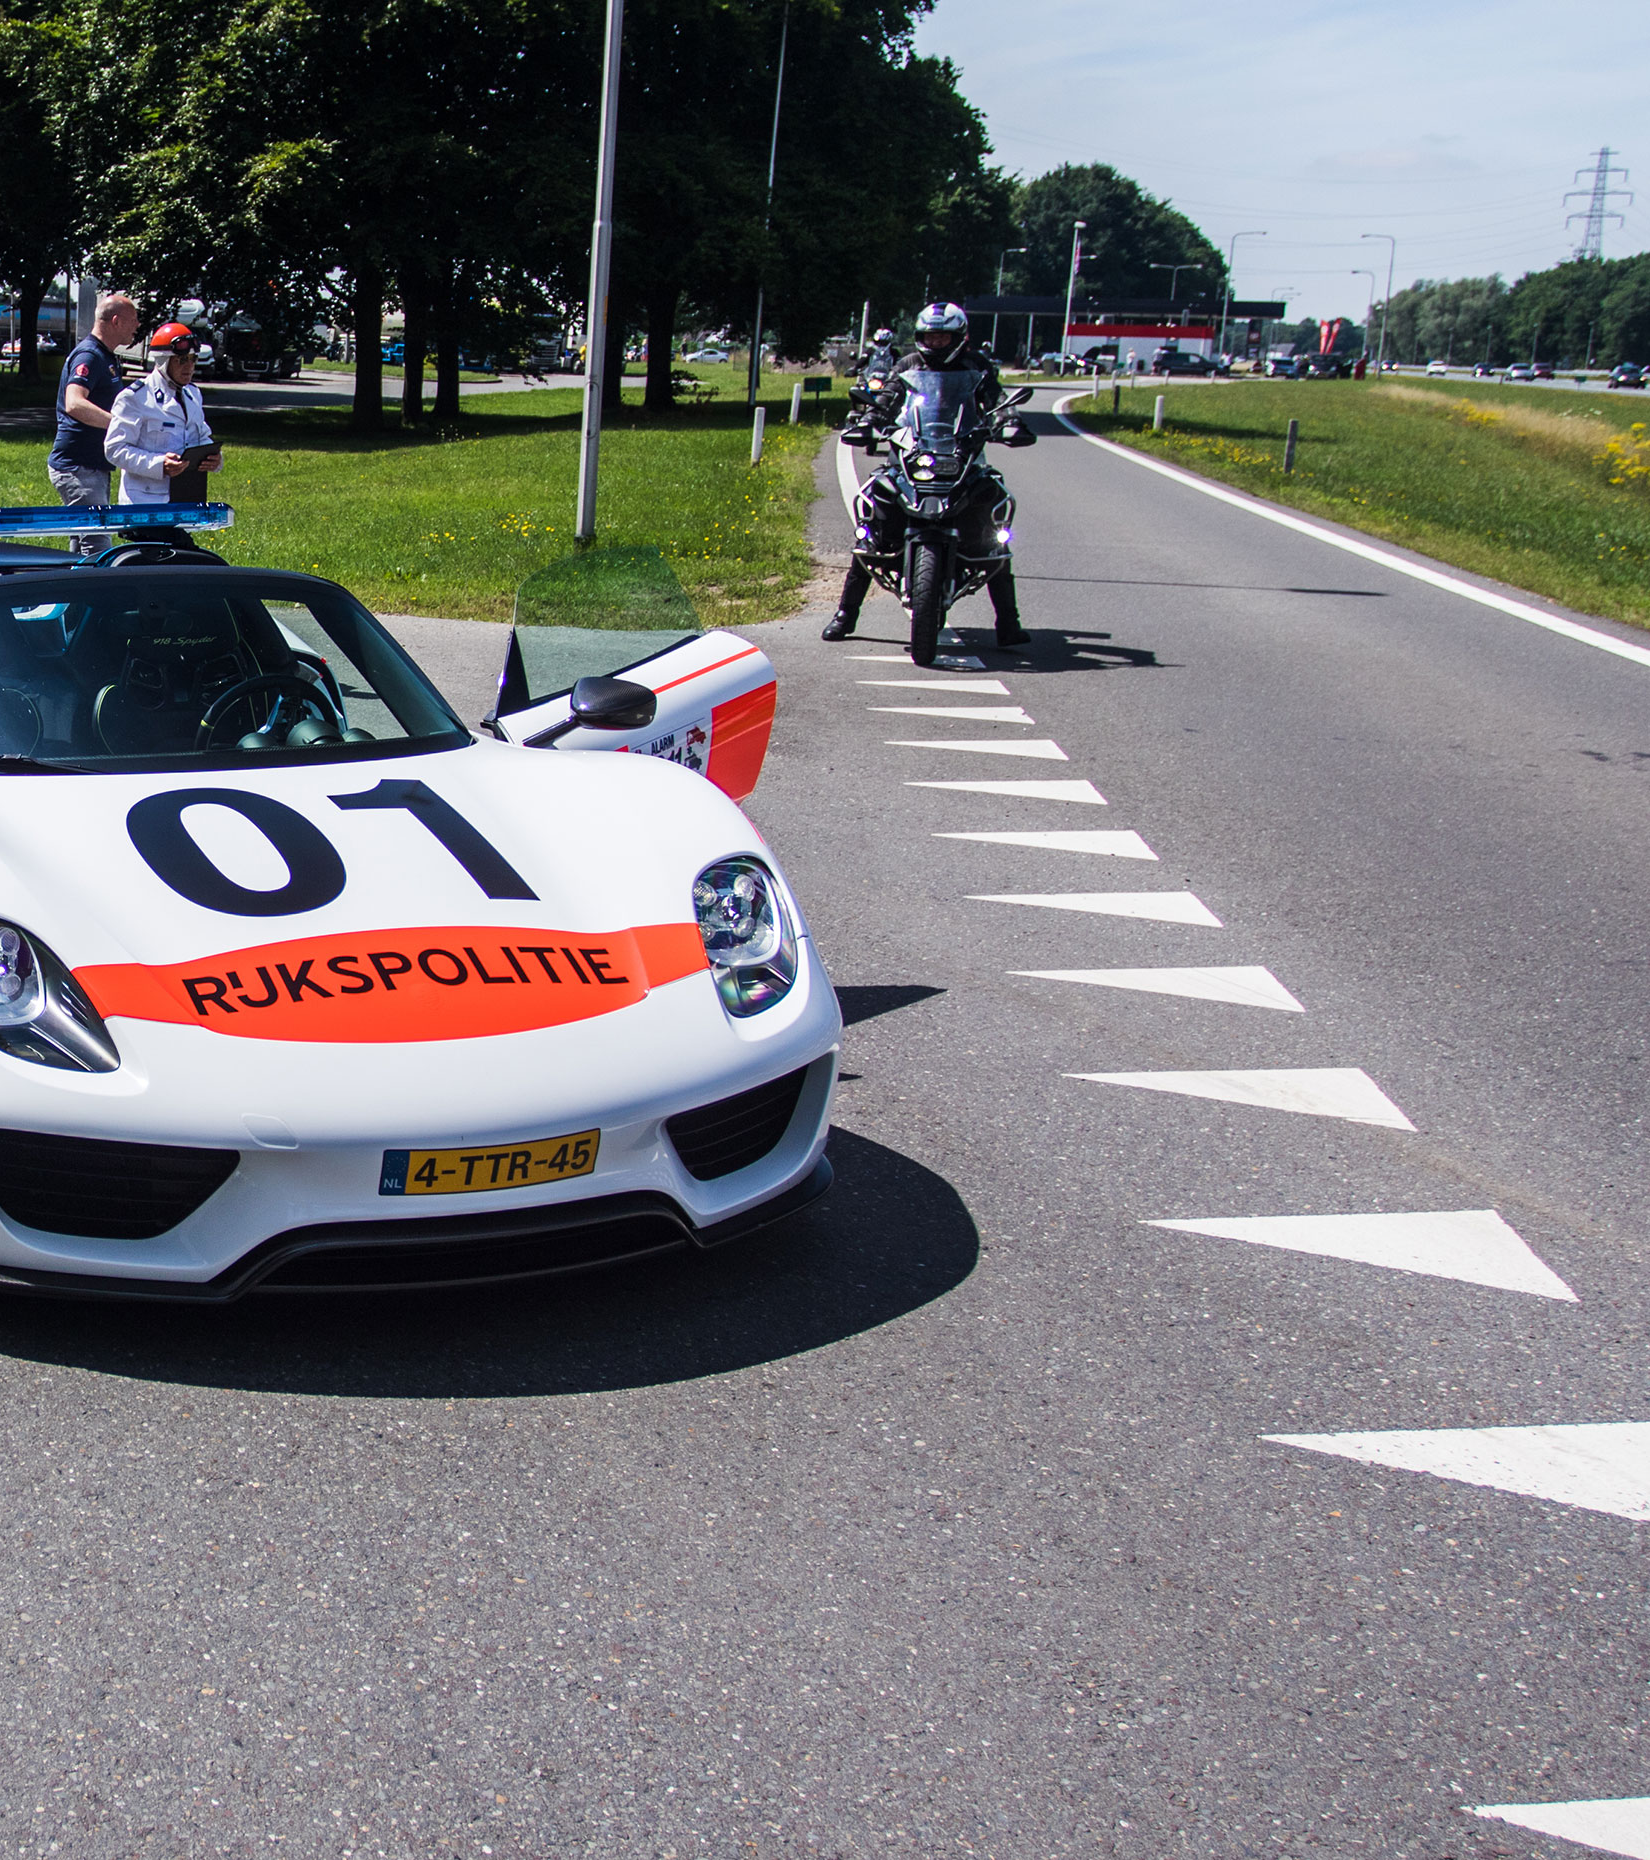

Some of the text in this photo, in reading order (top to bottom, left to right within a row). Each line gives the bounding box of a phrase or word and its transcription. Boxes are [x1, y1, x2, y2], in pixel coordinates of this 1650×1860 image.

[172, 635, 218, 647] Spyder
[651, 734, 675, 755] ALARM
[126, 779, 541, 917] 01
[383, 1138, 592, 1189] NL 4-TTR-45
